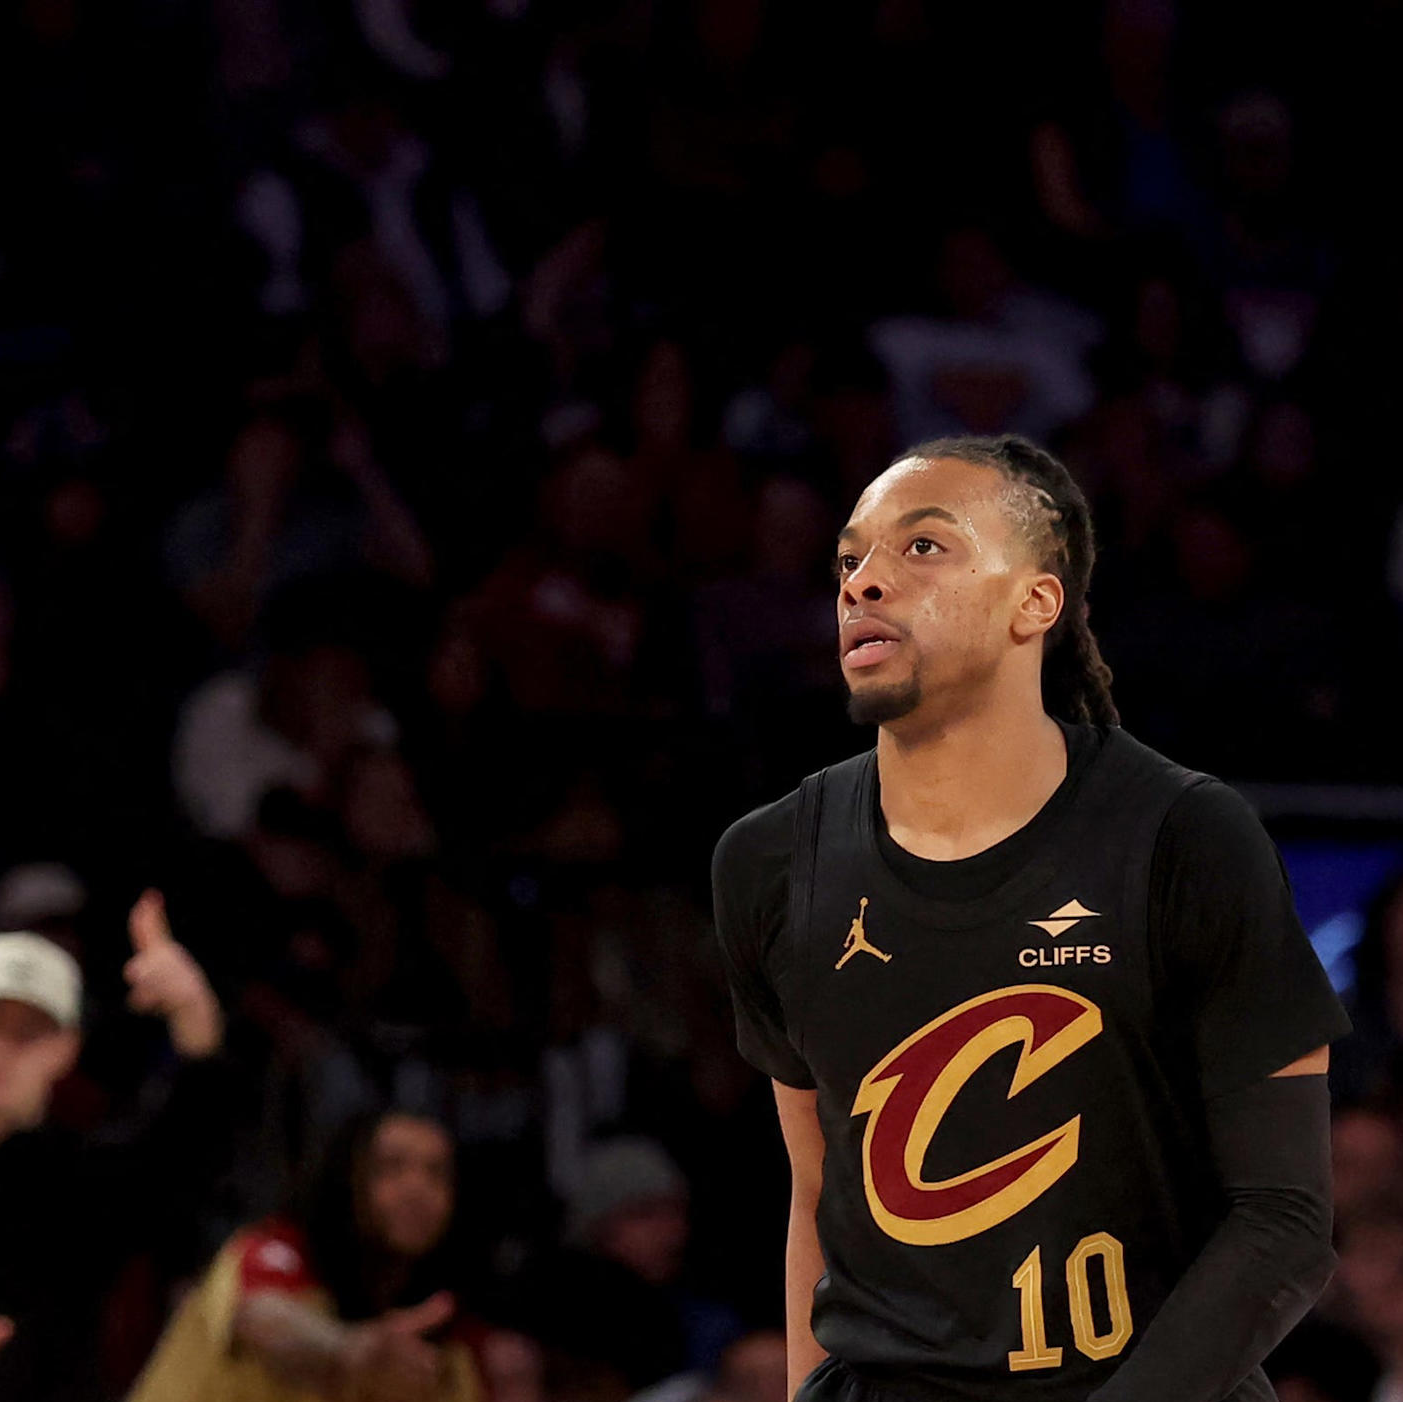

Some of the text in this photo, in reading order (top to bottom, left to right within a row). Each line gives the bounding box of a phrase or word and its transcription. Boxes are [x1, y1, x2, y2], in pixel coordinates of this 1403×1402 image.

[1018, 944, 1112, 968] CLIFFS
[851, 983, 1103, 1246] C
[1008, 1231, 1134, 1372] 10
